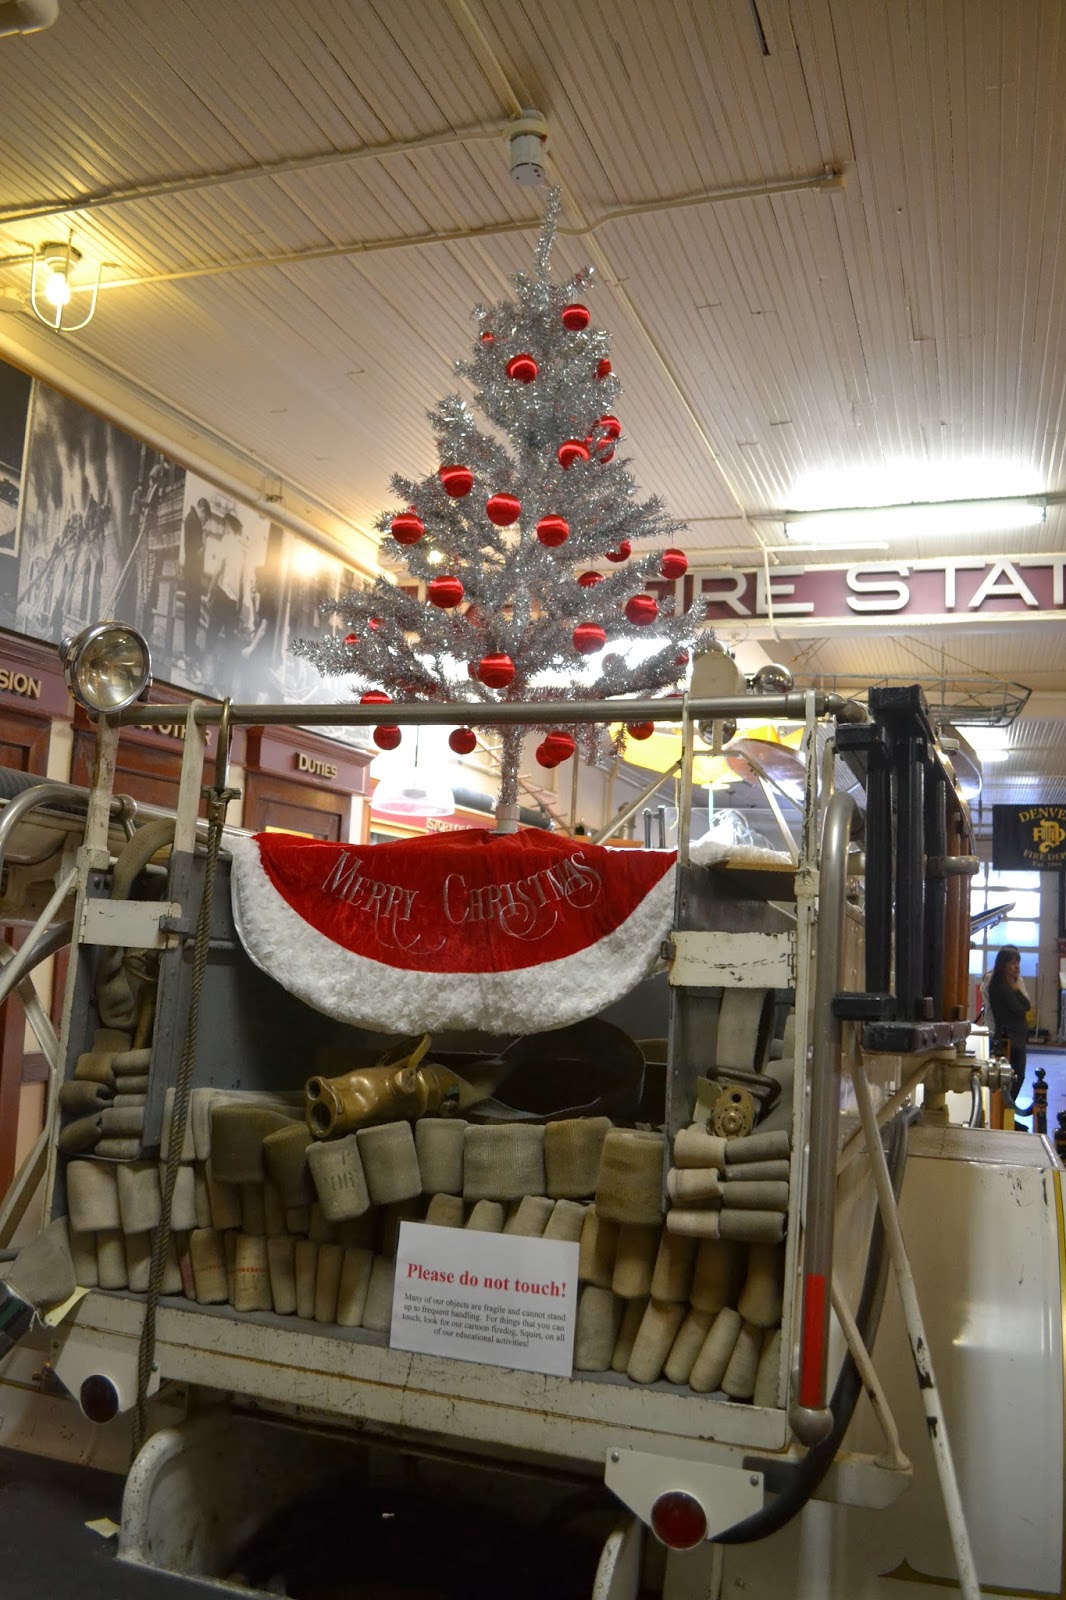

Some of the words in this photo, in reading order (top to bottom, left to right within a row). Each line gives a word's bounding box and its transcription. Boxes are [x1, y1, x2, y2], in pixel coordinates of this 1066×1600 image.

[846, 555, 1066, 611] STAT
[0, 668, 42, 698] SION
[321, 849, 446, 954] MERRY
[443, 851, 601, 940] CHRISTMAS
[407, 1263, 455, 1284] Please
[459, 1270, 479, 1287] do
[483, 1276, 510, 1292] not
[514, 1278, 567, 1298] touch!
[404, 1292, 422, 1303] Many
[424, 1296, 432, 1304] of
[445, 1299, 470, 1308] objects
[484, 1304, 506, 1314] fragile
[522, 1310, 545, 1319] cannot
[547, 1313, 566, 1321] stand
[404, 1304, 412, 1312] up
[421, 1305, 450, 1316] frequent
[451, 1310, 481, 1322] handling.
[486, 1314, 498, 1322] For
[499, 1317, 520, 1327] things
[522, 1319, 536, 1328] that
[537, 1322, 550, 1330] you
[402, 1313, 422, 1322] touch,
[423, 1315, 438, 1324] look
[440, 1318, 450, 1326] for
[464, 1322, 490, 1331] cartoon
[556, 1333, 565, 1342] all
[455, 1331, 494, 1343] educational
[495, 1337, 529, 1348] activities!
